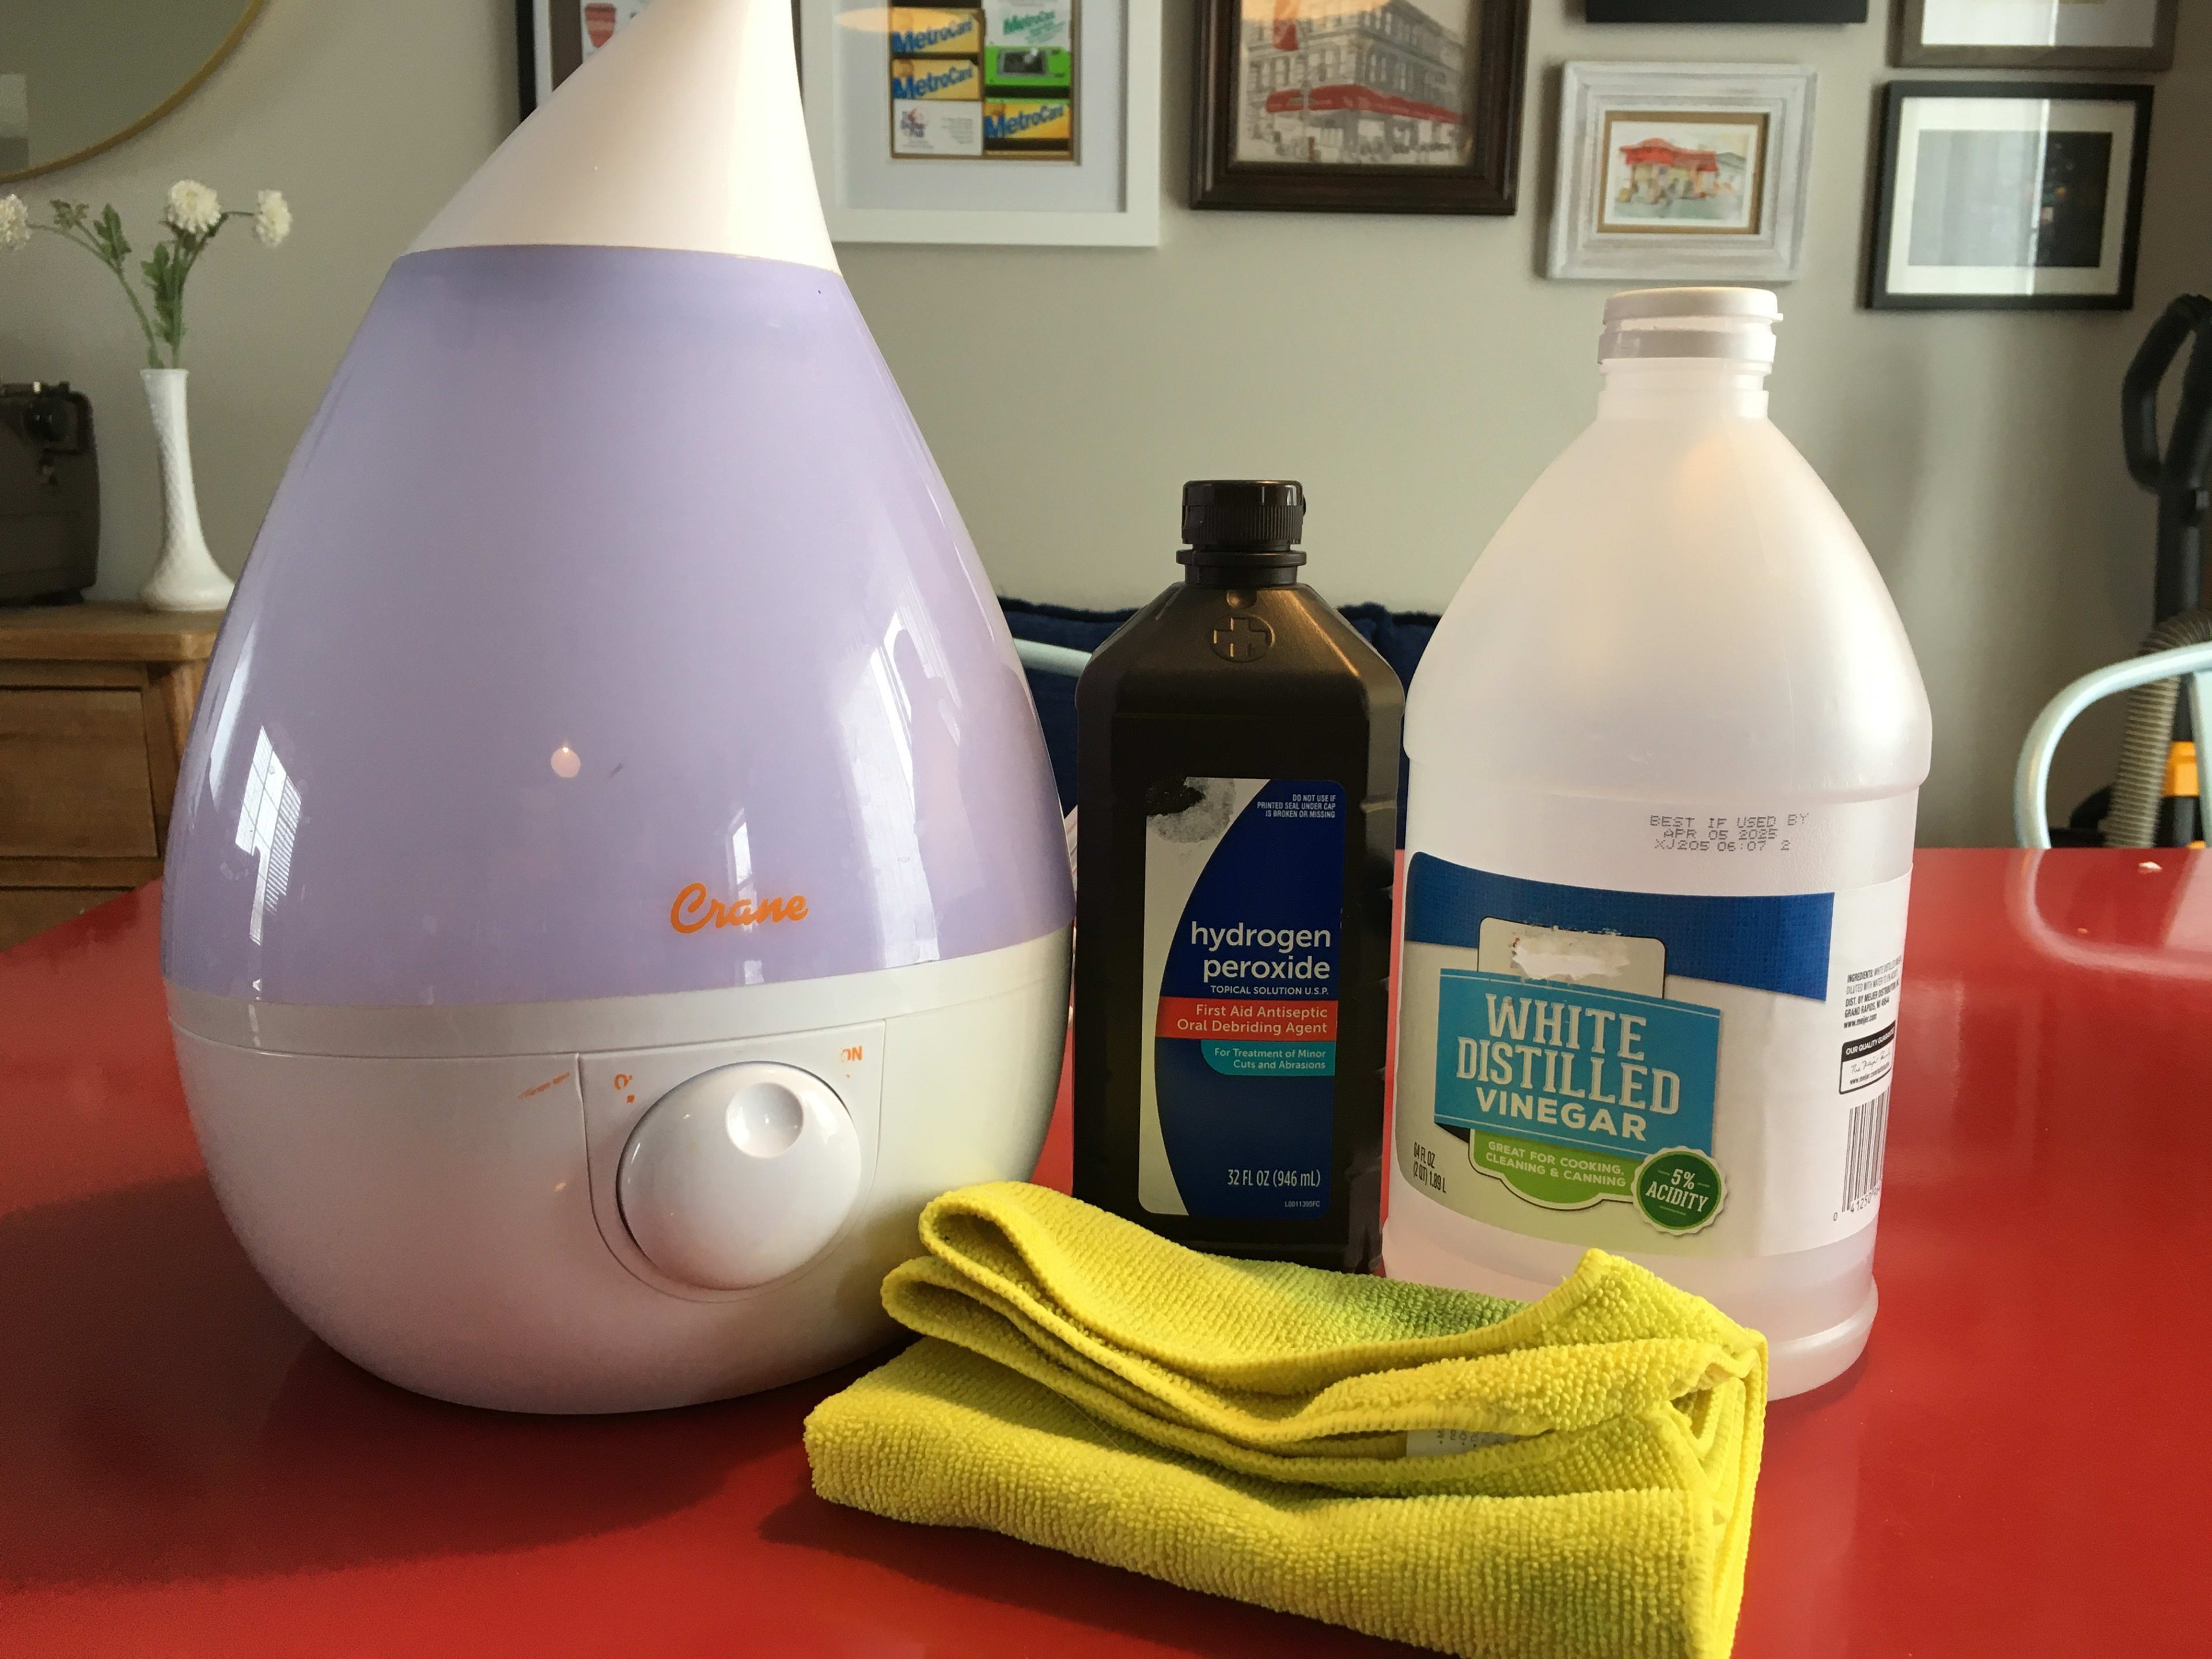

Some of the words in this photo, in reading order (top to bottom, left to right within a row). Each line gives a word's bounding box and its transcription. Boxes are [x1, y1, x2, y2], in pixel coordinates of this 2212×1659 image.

[892, 66, 973, 99] MetroCard
[984, 104, 1063, 139] MetroCard
[1257, 801, 1283, 809] PRINTED
[1323, 802, 1336, 810] CAP
[1292, 794, 1301, 802] DO
[1650, 815, 1695, 827] BEST
[1708, 817, 1727, 828] IF
[1737, 816, 1777, 828] USED
[1787, 813, 1809, 825] BY
[1664, 828, 1697, 839] APR
[1708, 830, 1728, 840] 05
[1738, 828, 1778, 840] 2025
[1654, 839, 1710, 851] XJ205
[1717, 840, 1767, 851] 06:07
[1781, 840, 1790, 851] 2
[670, 882, 809, 934] Crane
[1191, 921, 1331, 953] hydrogen
[1203, 956, 1331, 983] peroxide
[1210, 985, 1251, 995] TOPICAL
[1253, 986, 1302, 995] SOLUTION
[1304, 987, 1329, 995] U.S.P.
[1858, 995, 1863, 1004] BY
[1196, 1004, 1226, 1016] First
[1230, 1005, 1253, 1017] Aid
[1256, 1006, 1328, 1021] Antiseptic
[1844, 1006, 1860, 1018] GRAND
[1177, 1018, 1207, 1032] Oral
[1212, 1020, 1282, 1036] Debriding
[1285, 1022, 1327, 1036] Agent
[1485, 992, 1647, 1062] WHITE
[1214, 1048, 1230, 1056] For
[1233, 1048, 1283, 1058] Treatment
[1285, 1049, 1296, 1058] of
[1297, 1049, 1326, 1058] Minor
[1846, 1046, 1858, 1055] OUR
[1858, 1039, 1878, 1051] QUALITY
[1233, 1059, 1256, 1069] Cuts
[1257, 1059, 1276, 1069] and
[1278, 1060, 1325, 1069] Abrasions
[1456, 1036, 1681, 1115] DISTILLED
[1476, 1086, 1646, 1142] VINEGAR
[1421, 1146, 1426, 1164] FL
[1427, 1150, 1435, 1169] OZ
[1488, 1141, 1526, 1157] GREAT
[1530, 1150, 1555, 1164] FOR
[1560, 1158, 1624, 1176] COOKING,
[1228, 1169, 1240, 1185] 32
[1243, 1170, 1253, 1186] FL
[1256, 1170, 1270, 1186] OZ
[1272, 1169, 1297, 1188] (946
[1300, 1169, 1321, 1188] mL)
[1413, 1160, 1418, 1178] (2
[1419, 1164, 1427, 1186] QT)
[1429, 1170, 1441, 1191] 1.89
[1442, 1177, 1446, 1194] L
[1486, 1154, 1546, 1176] CLEANING
[1550, 1167, 1559, 1178] &
[1563, 1169, 1626, 1187] CANNING
[1671, 1169, 1695, 1190] 5%
[1645, 1181, 1710, 1213] ACIDITY
[1833, 1211, 1838, 1221] 0
